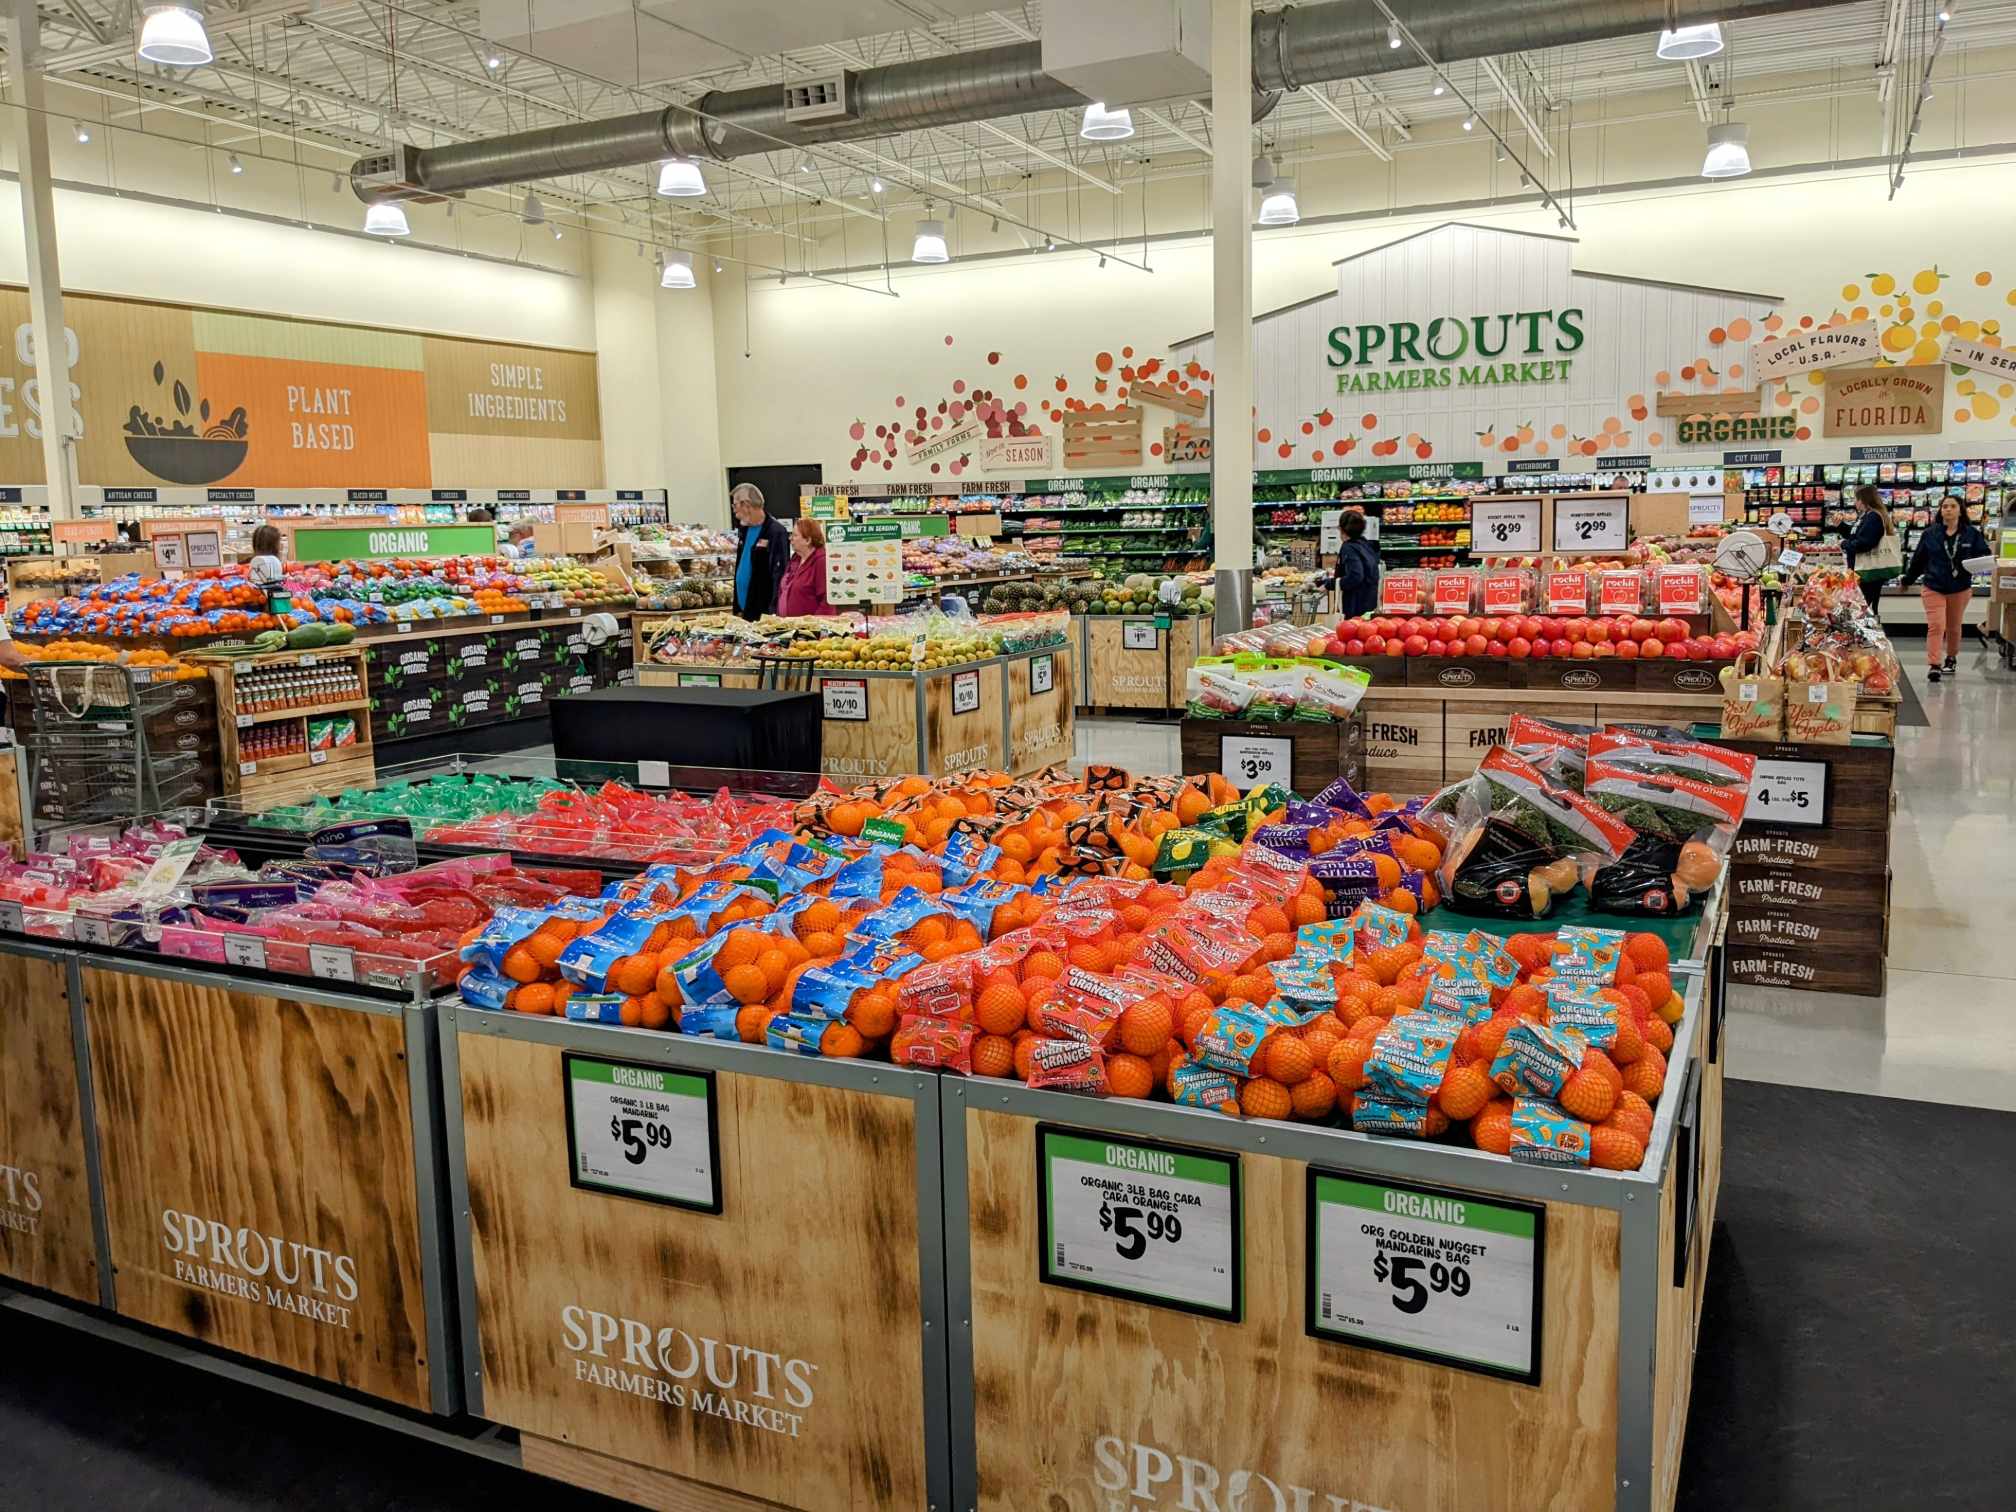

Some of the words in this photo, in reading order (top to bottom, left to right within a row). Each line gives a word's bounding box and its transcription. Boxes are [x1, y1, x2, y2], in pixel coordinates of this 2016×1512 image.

[1326, 308, 1585, 367] SPROUTS
[1767, 341, 1806, 366] LOCAL
[1809, 334, 1868, 348] FLAVORS
[1968, 350, 1985, 361] IN
[1798, 352, 1836, 365] U.S.A.
[490, 363, 543, 390] SIMPLE
[1336, 366, 1452, 395] FARMERS
[1459, 359, 1573, 386] MARKET
[1838, 376, 1889, 397] LOCALLY
[1892, 376, 1934, 395] GROWN
[287, 385, 352, 416] PLANT
[468, 393, 567, 423] INGREDIENTS
[1835, 405, 1927, 427] FLORIDA
[291, 423, 355, 450] BASED
[1678, 415, 1797, 443] ORGANIC
[918, 440, 944, 460] FAMILY
[945, 431, 972, 449] FARMS
[1005, 447, 1043, 463] SEASON
[1734, 453, 1749, 462] CUT
[1750, 453, 1770, 462] FRUIT
[1409, 464, 1455, 479] ORGANIC
[1515, 462, 1551, 471] MUSHROOMS
[1131, 475, 1168, 489] ORGANIC
[1310, 468, 1353, 482] ORGANIC
[815, 486, 834, 496] FARM
[836, 486, 860, 496] FRESH
[887, 485, 907, 495] FARM
[908, 484, 933, 495] FRESH
[962, 483, 984, 493] FARM
[985, 482, 1010, 493] FRESH
[1047, 479, 1084, 491] ORGANIC
[368, 532, 429, 555] ORGANIC
[1387, 580, 1413, 589] rockit
[1438, 578, 1465, 587] rockit
[1488, 579, 1516, 589] rockit
[1551, 574, 1581, 585] rockit
[1606, 578, 1635, 588] rockit
[1663, 576, 1694, 586] rockit
[460, 645, 488, 657] ORGANIC
[515, 639, 541, 651] ORGANIC
[400, 651, 430, 666] ORGANIC
[463, 655, 486, 667] PRODUCE
[518, 649, 540, 660] PRODUCE
[403, 663, 428, 675] PRODUCE
[1676, 673, 1713, 686] SPROUTS
[517, 682, 543, 695] ORGANIC
[463, 690, 490, 704] ORGANIC
[520, 692, 542, 704] PRODUCE
[403, 698, 432, 713] ORGANIC
[465, 701, 489, 712] PRODUCE
[406, 710, 431, 723] PRODUCE
[943, 744, 989, 771] SPROUTS
[822, 758, 887, 776] PROUTS
[1656, 774, 1682, 786] UNLIKE
[1683, 781, 1701, 792] ANY
[1702, 784, 1734, 800] OTHER?
[1758, 789, 1770, 805] 4
[1790, 790, 1809, 807] $5
[864, 827, 901, 842] ORGANIC
[1735, 838, 1819, 859] FARM-FRESH
[1757, 853, 1795, 865] Produce
[1738, 879, 1823, 900] FARM-FRESH
[1761, 893, 1798, 906] Produce
[1737, 919, 1820, 940] FARM-FRESH
[1759, 934, 1795, 945] Produce
[1560, 967, 1600, 977] ORGANIC
[1732, 959, 1815, 980] FARM-FRESH
[1754, 974, 1790, 986] Produce
[1559, 1005, 1601, 1016] ORGANIC
[1041, 1047, 1093, 1071] ORANGES
[1373, 1051, 1441, 1077] MANDARINS
[1385, 1047, 1430, 1066] ORGANIC
[612, 1066, 664, 1091] ORGANIC
[610, 1095, 638, 1107] ORGANIC
[646, 1102, 655, 1110] LB
[656, 1103, 670, 1112] BAG
[1105, 1144, 1175, 1176] ORGANIC
[1080, 1176, 1124, 1193] ORGANIC
[1126, 1184, 1146, 1196] 3LB
[1149, 1187, 1170, 1201] BAG
[1174, 1192, 1202, 1207] CARA
[1102, 1190, 1129, 1205] CARA
[1132, 1195, 1179, 1213] ORANGES
[1383, 1190, 1466, 1225] ORGANIC
[1360, 1223, 1385, 1237] ORG
[1389, 1229, 1435, 1247] GOLDEN
[1439, 1238, 1487, 1257] NUGGET
[161, 1208, 359, 1302] SPROUTS
[1375, 1238, 1441, 1260] MANDARINS
[1446, 1252, 1471, 1266] BAG
[174, 1258, 261, 1302] FARMERS
[265, 1284, 352, 1330] MARKET
[560, 1304, 816, 1409] SPROUTS
[574, 1358, 687, 1408] FARMERS
[691, 1387, 802, 1439] MARKET
